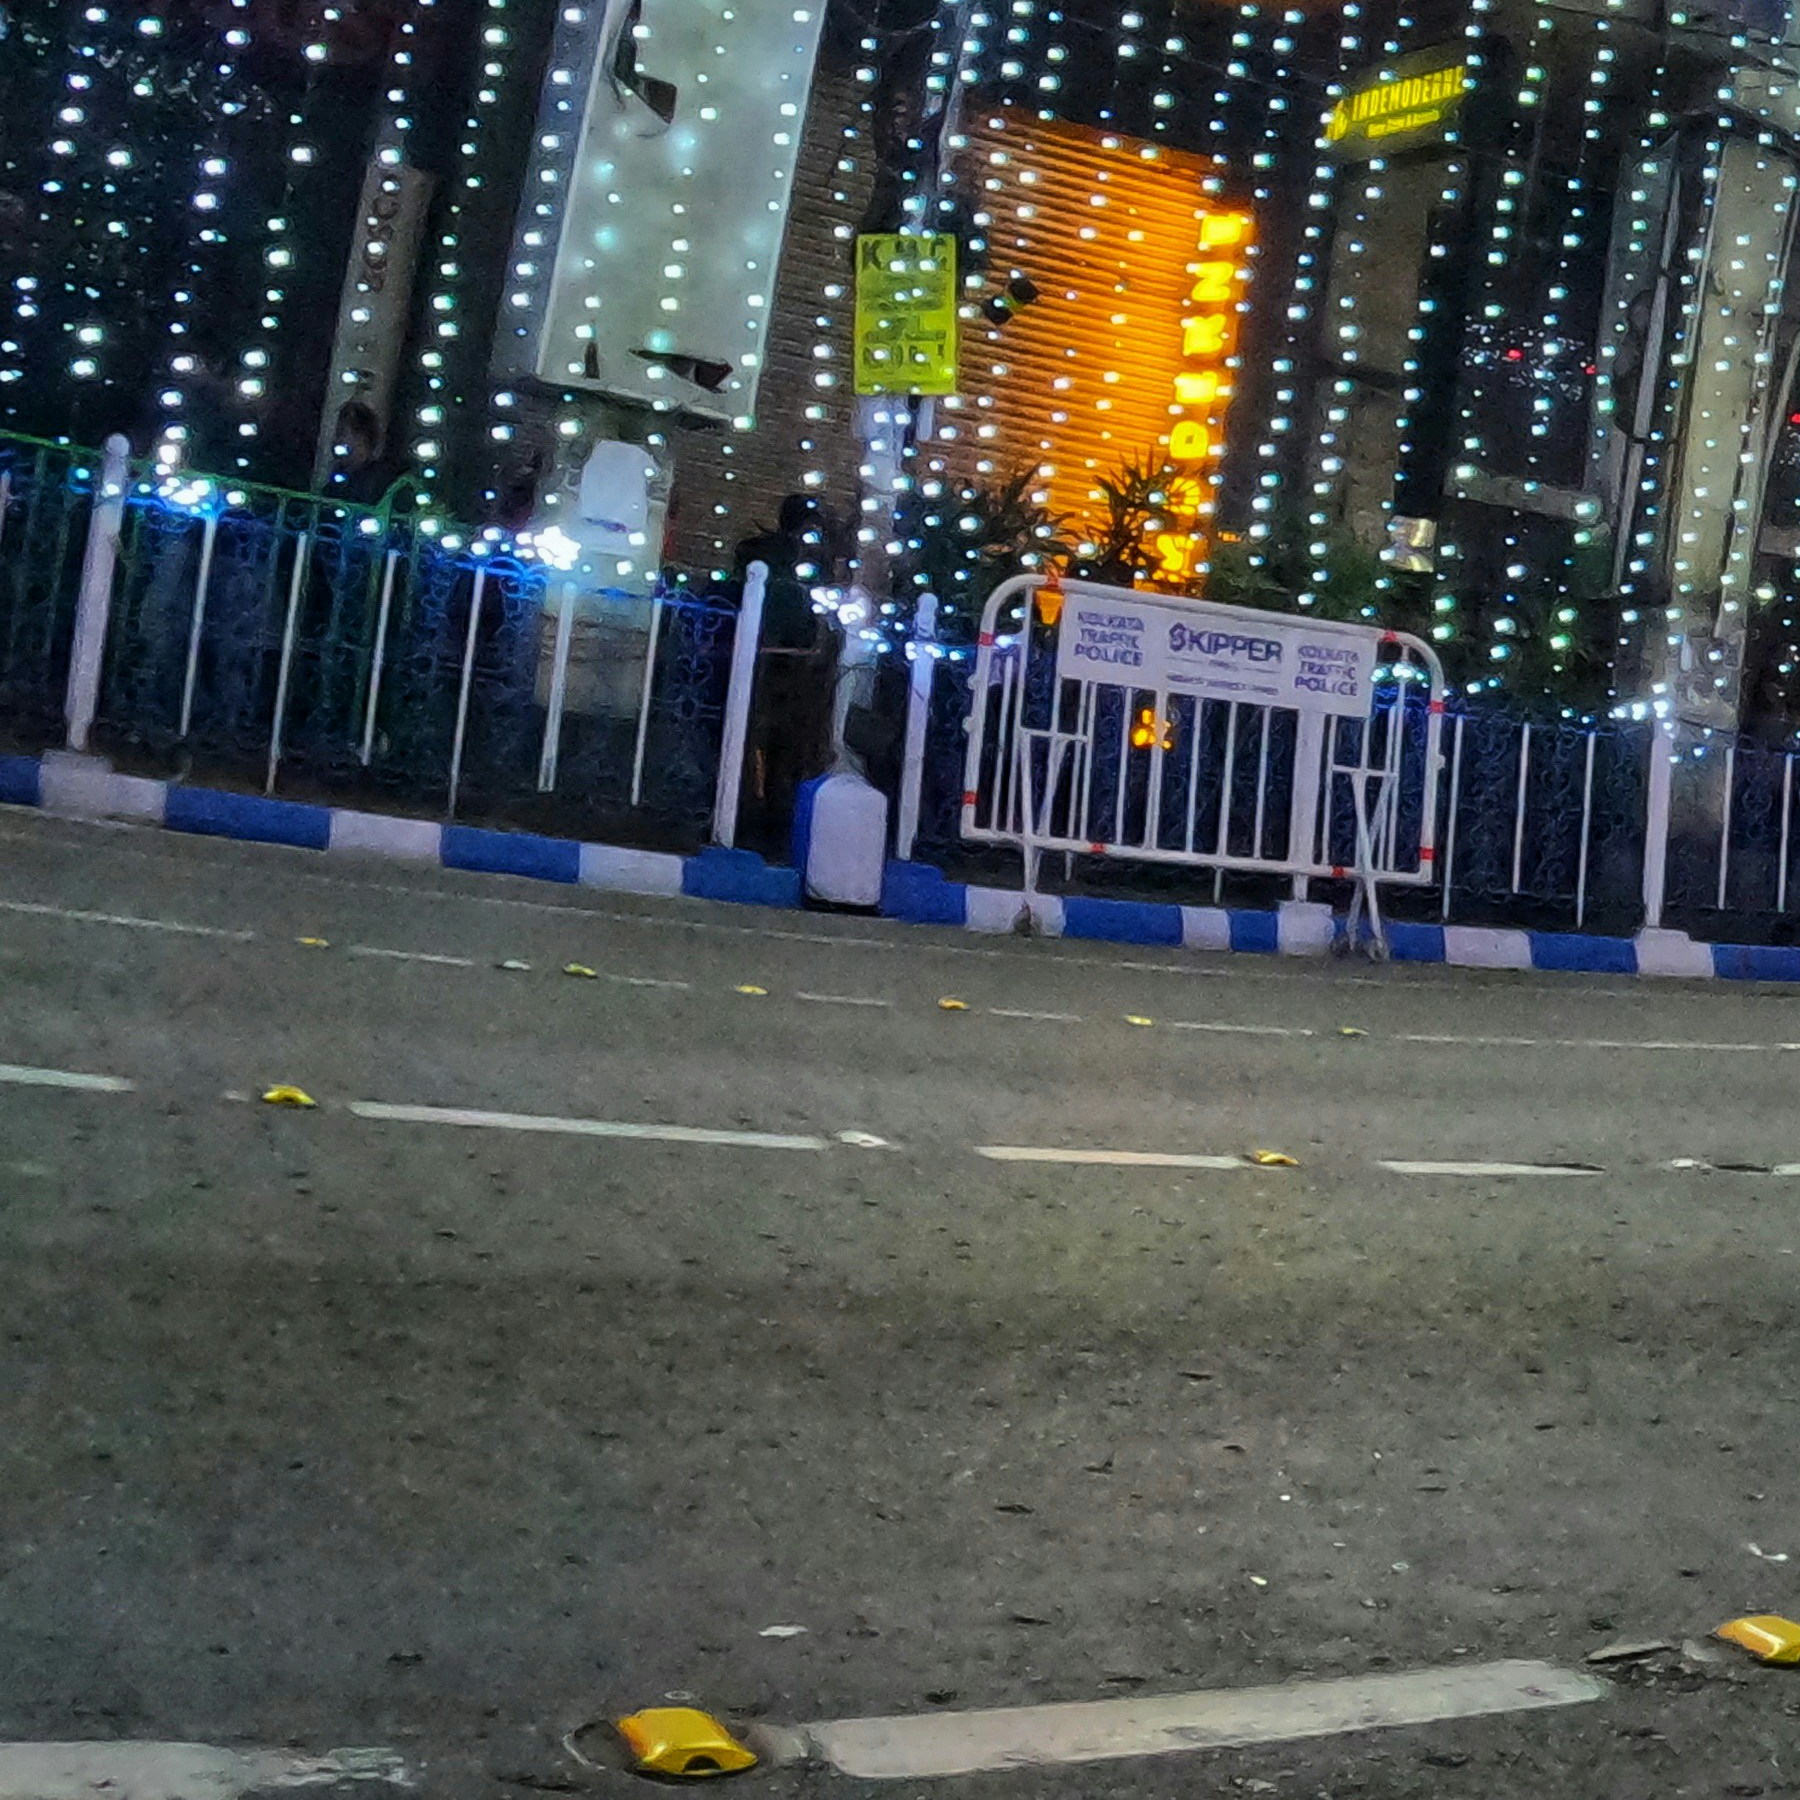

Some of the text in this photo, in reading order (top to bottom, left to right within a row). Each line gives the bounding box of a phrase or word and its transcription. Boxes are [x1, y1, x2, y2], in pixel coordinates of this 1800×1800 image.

[1351, 65, 1467, 122] INDEMODERNE
[1074, 643, 1144, 667] POLICE
[1168, 621, 1284, 664] SKIPPER
[1293, 676, 1359, 697] POLICE
